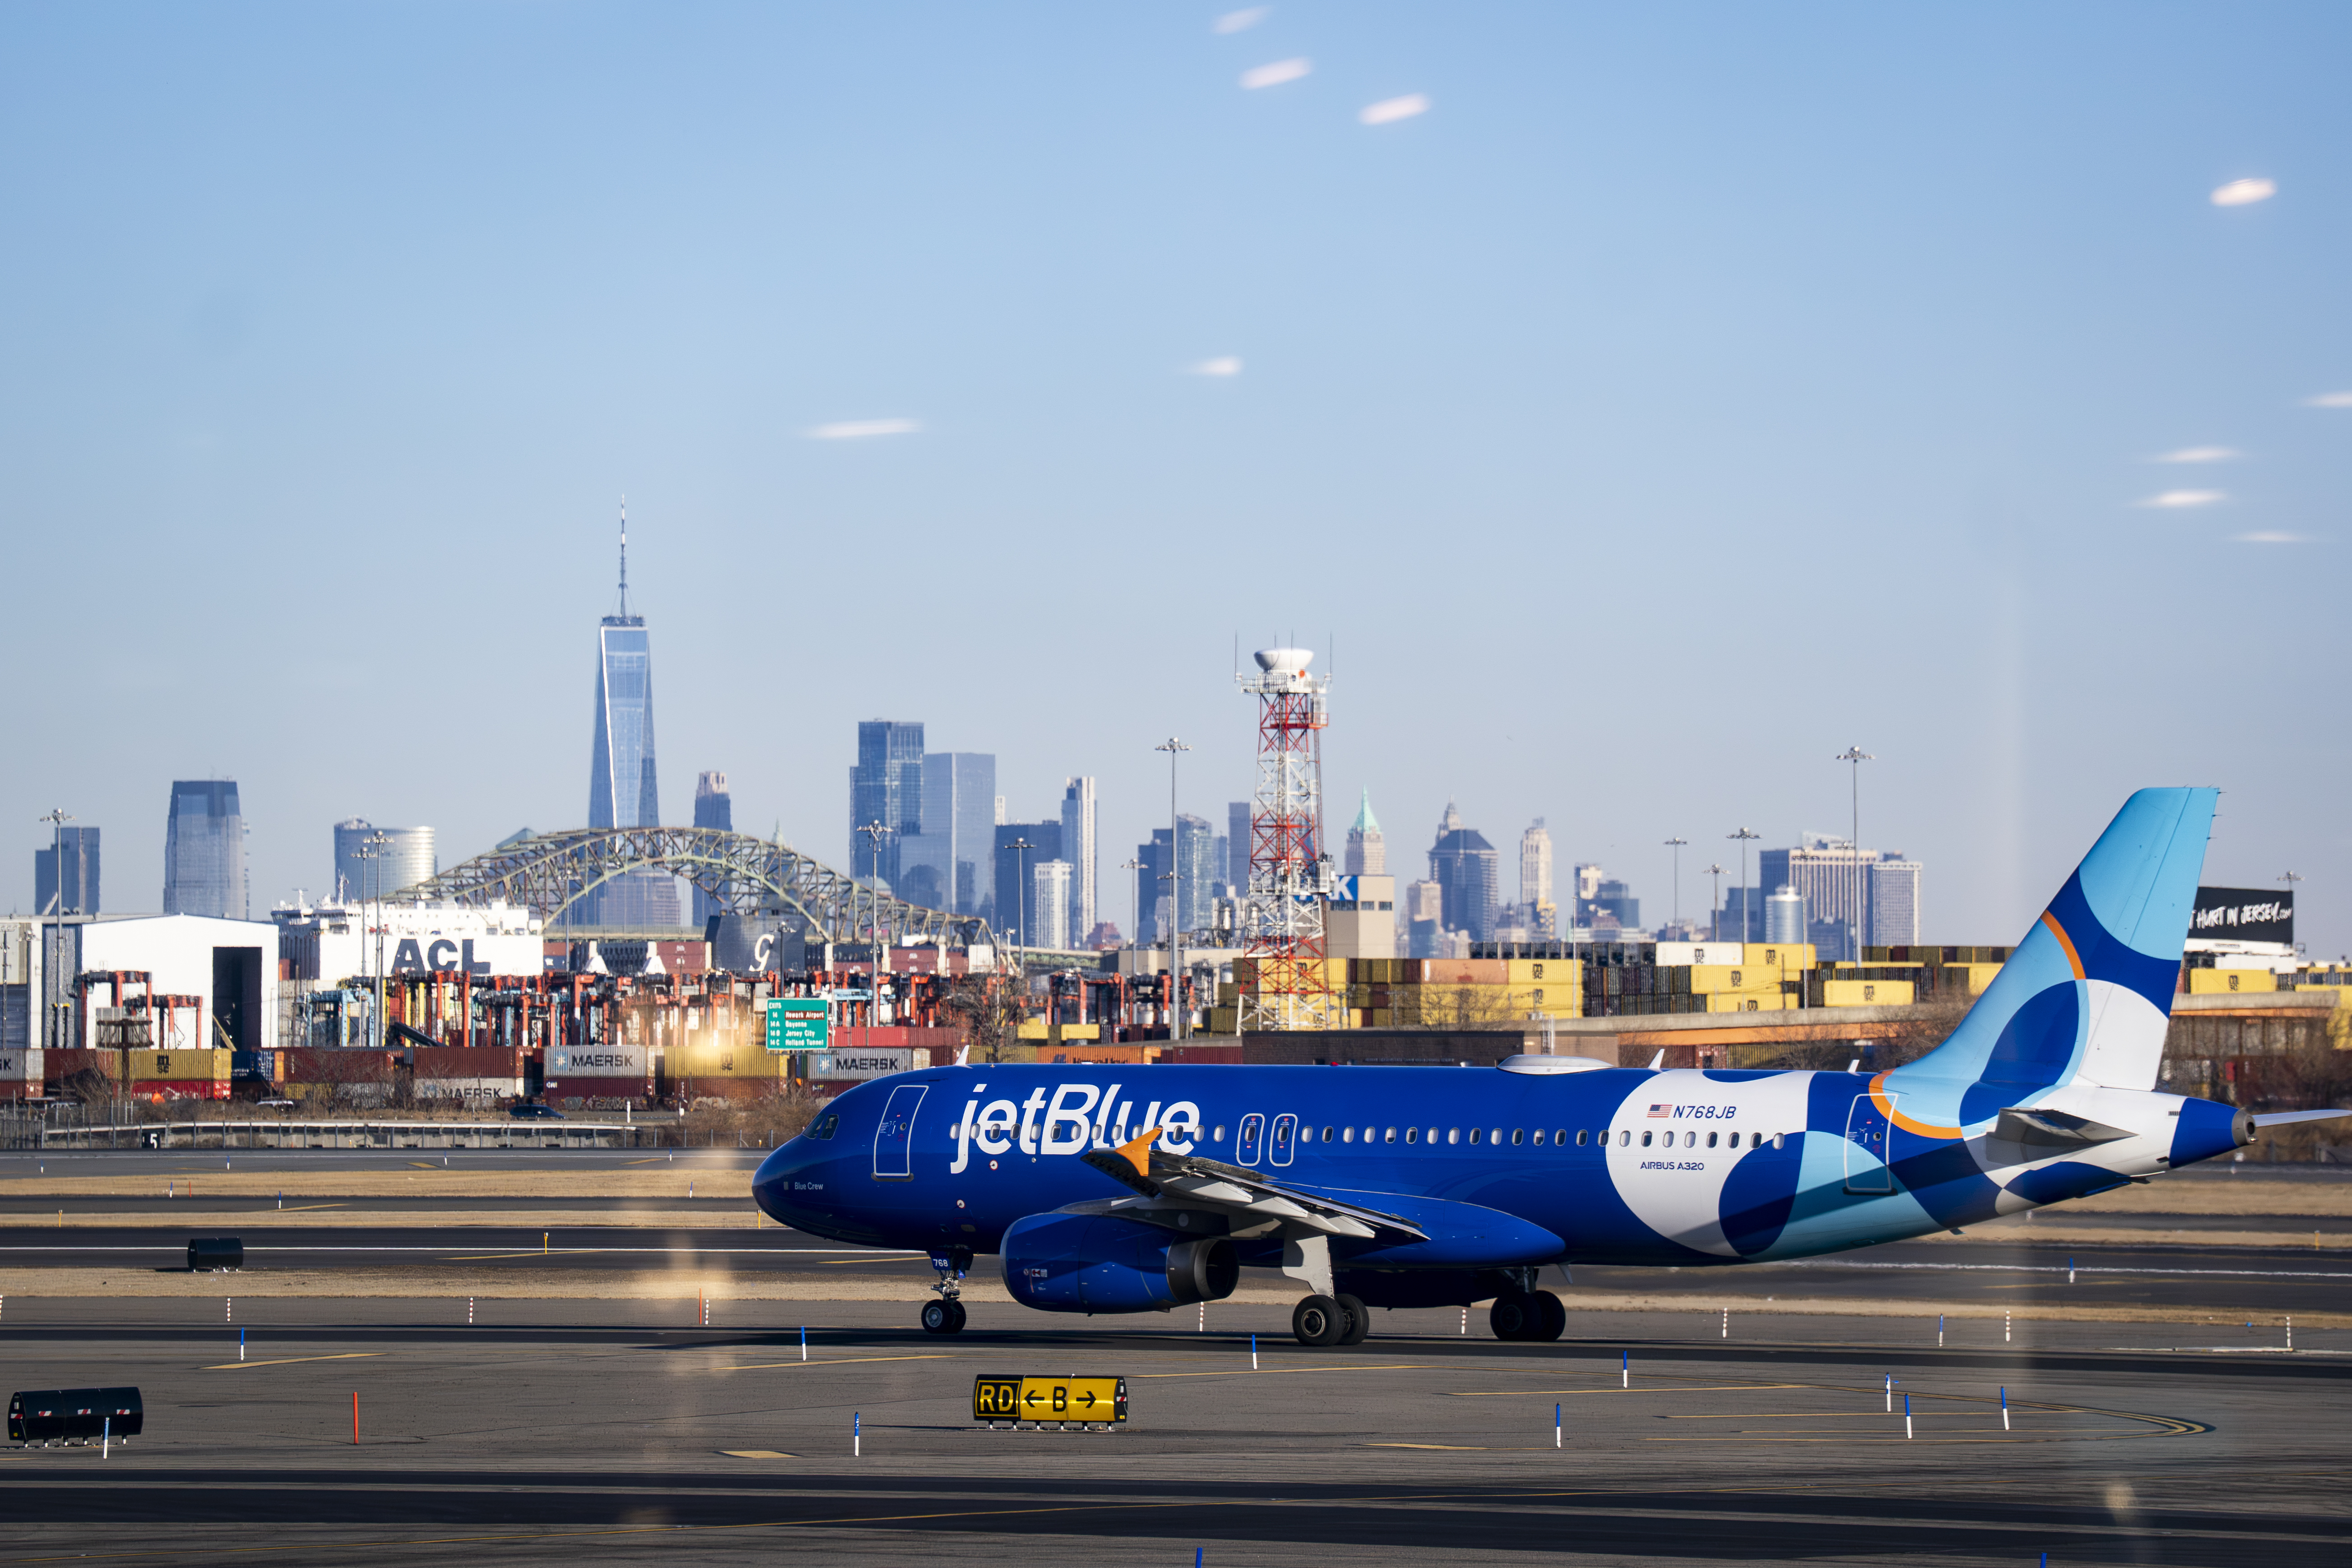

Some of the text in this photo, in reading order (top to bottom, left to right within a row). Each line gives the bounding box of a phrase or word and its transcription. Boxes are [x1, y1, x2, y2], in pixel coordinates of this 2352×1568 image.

[2196, 906, 2227, 929] HURT
[2227, 906, 2239, 927] IN
[391, 939, 491, 974] ACL
[785, 1021, 807, 1029] Bayonne
[785, 1030, 803, 1038] Jersey
[804, 1030, 815, 1038] City
[572, 1055, 633, 1067] MAERSK
[836, 1058, 898, 1070] MAERSK
[1673, 1105, 1736, 1118] N768JB
[950, 1084, 1200, 1174] jetBlue
[1640, 1161, 1704, 1170] AIRBUS A320
[933, 1259, 948, 1267] 768
[980, 1385, 1067, 1412] RD B
